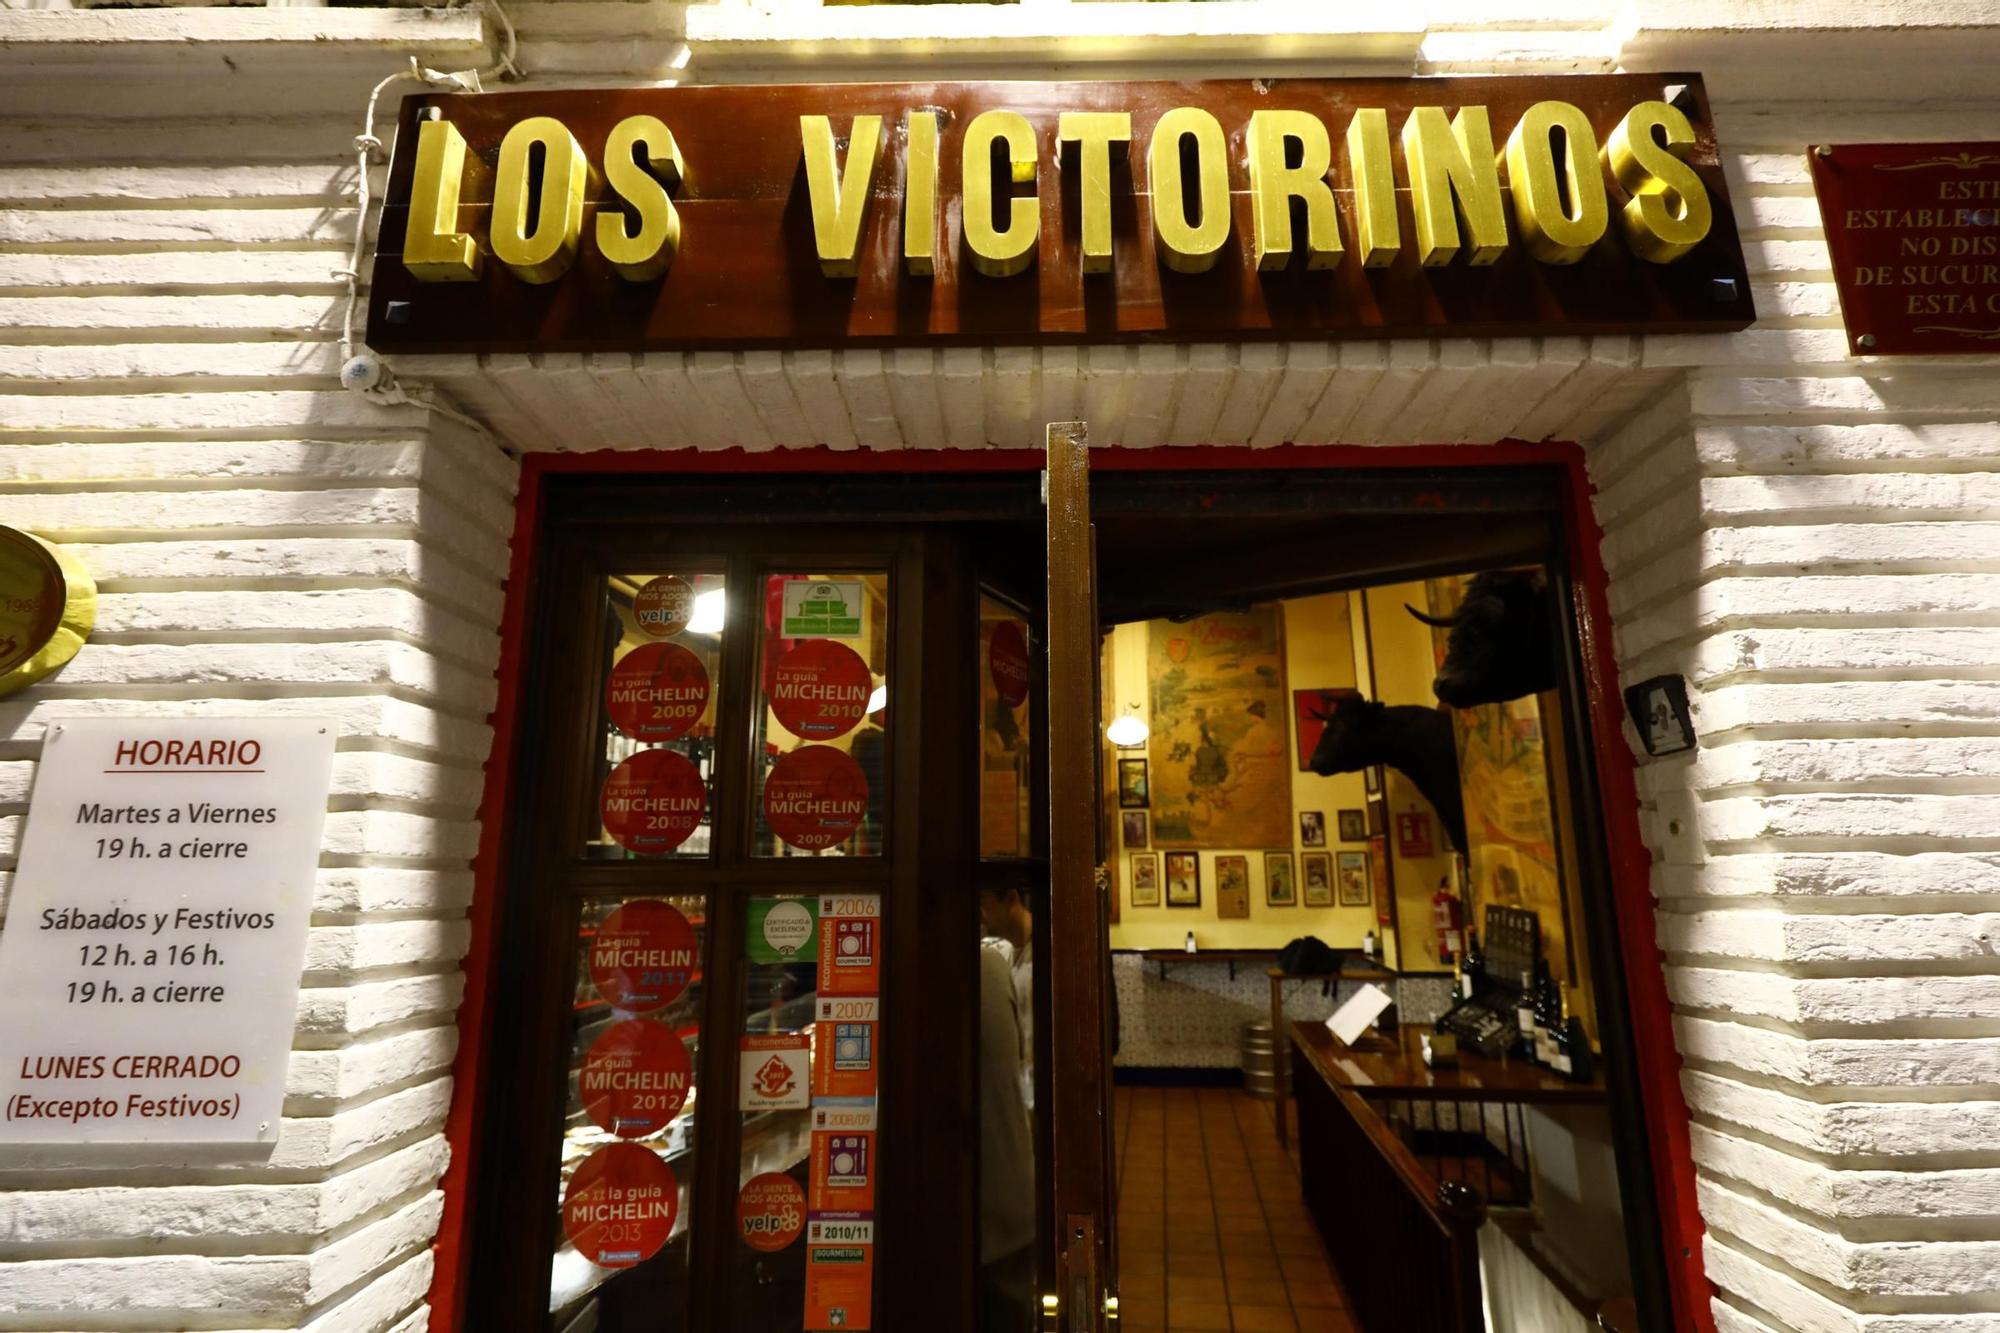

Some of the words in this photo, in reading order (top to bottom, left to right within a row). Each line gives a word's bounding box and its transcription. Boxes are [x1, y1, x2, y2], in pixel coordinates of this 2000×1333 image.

[403, 114, 682, 282] LOS
[800, 100, 1712, 277] VICTORINOS
[1900, 237, 1941, 256] NO
[1950, 236, 1998, 256] DIS
[1855, 266, 1893, 286] DE
[1901, 264, 2000, 285] SUCUR
[1906, 294, 1977, 314] ESTA
[640, 608, 673, 625] yelp
[776, 671, 789, 681] La
[612, 687, 704, 703] MICHELIN
[775, 684, 866, 700] MICHELIN
[652, 704, 697, 719] 2009
[818, 704, 862, 717] 2010
[114, 739, 261, 766] HORARIO
[76, 802, 161, 824] Martes
[166, 808, 181, 824] a
[188, 802, 277, 824] Viernes
[606, 798, 700, 812] MICHELIN
[770, 800, 860, 814] MICHELIN
[646, 816, 692, 829] 2008
[96, 838, 124, 859] 19
[129, 837, 151, 859] h.
[158, 842, 172, 859] a
[178, 837, 248, 859] cierre
[798, 834, 832, 845] 2007
[836, 899, 875, 915] 2006
[40, 907, 147, 930] Sábados
[152, 914, 167, 936] y
[174, 907, 275, 930] Festivos
[80, 944, 107, 967] 12
[113, 944, 137, 967] h.
[143, 949, 157, 966] a
[167, 944, 196, 966] 16
[202, 943, 225, 966] h.
[595, 949, 691, 967] MICHELIN
[822, 920, 832, 991] recomendado
[641, 971, 686, 986] 2011
[66, 981, 96, 1003] 19
[101, 980, 124, 1003] h.
[131, 986, 145, 1003] a
[152, 980, 225, 1003] cierre
[836, 1003, 874, 1019] 2007
[20, 1055, 105, 1079] LUNES
[112, 1054, 241, 1079] CERRADO
[585, 1072, 685, 1089] MICHELIN
[6, 1094, 119, 1124] (Excepto
[125, 1092, 241, 1120] Festivos)
[632, 1095, 680, 1110] 2012
[608, 1186, 622, 1200] la
[750, 1184, 761, 1193] LA
[763, 1184, 794, 1193] GENTE
[766, 1194, 802, 1204] ADORA
[571, 1201, 669, 1223] MICHELIN
[744, 1214, 781, 1234] yelp
[598, 1223, 641, 1243] 2013
[824, 1226, 869, 1240] 2010/11
